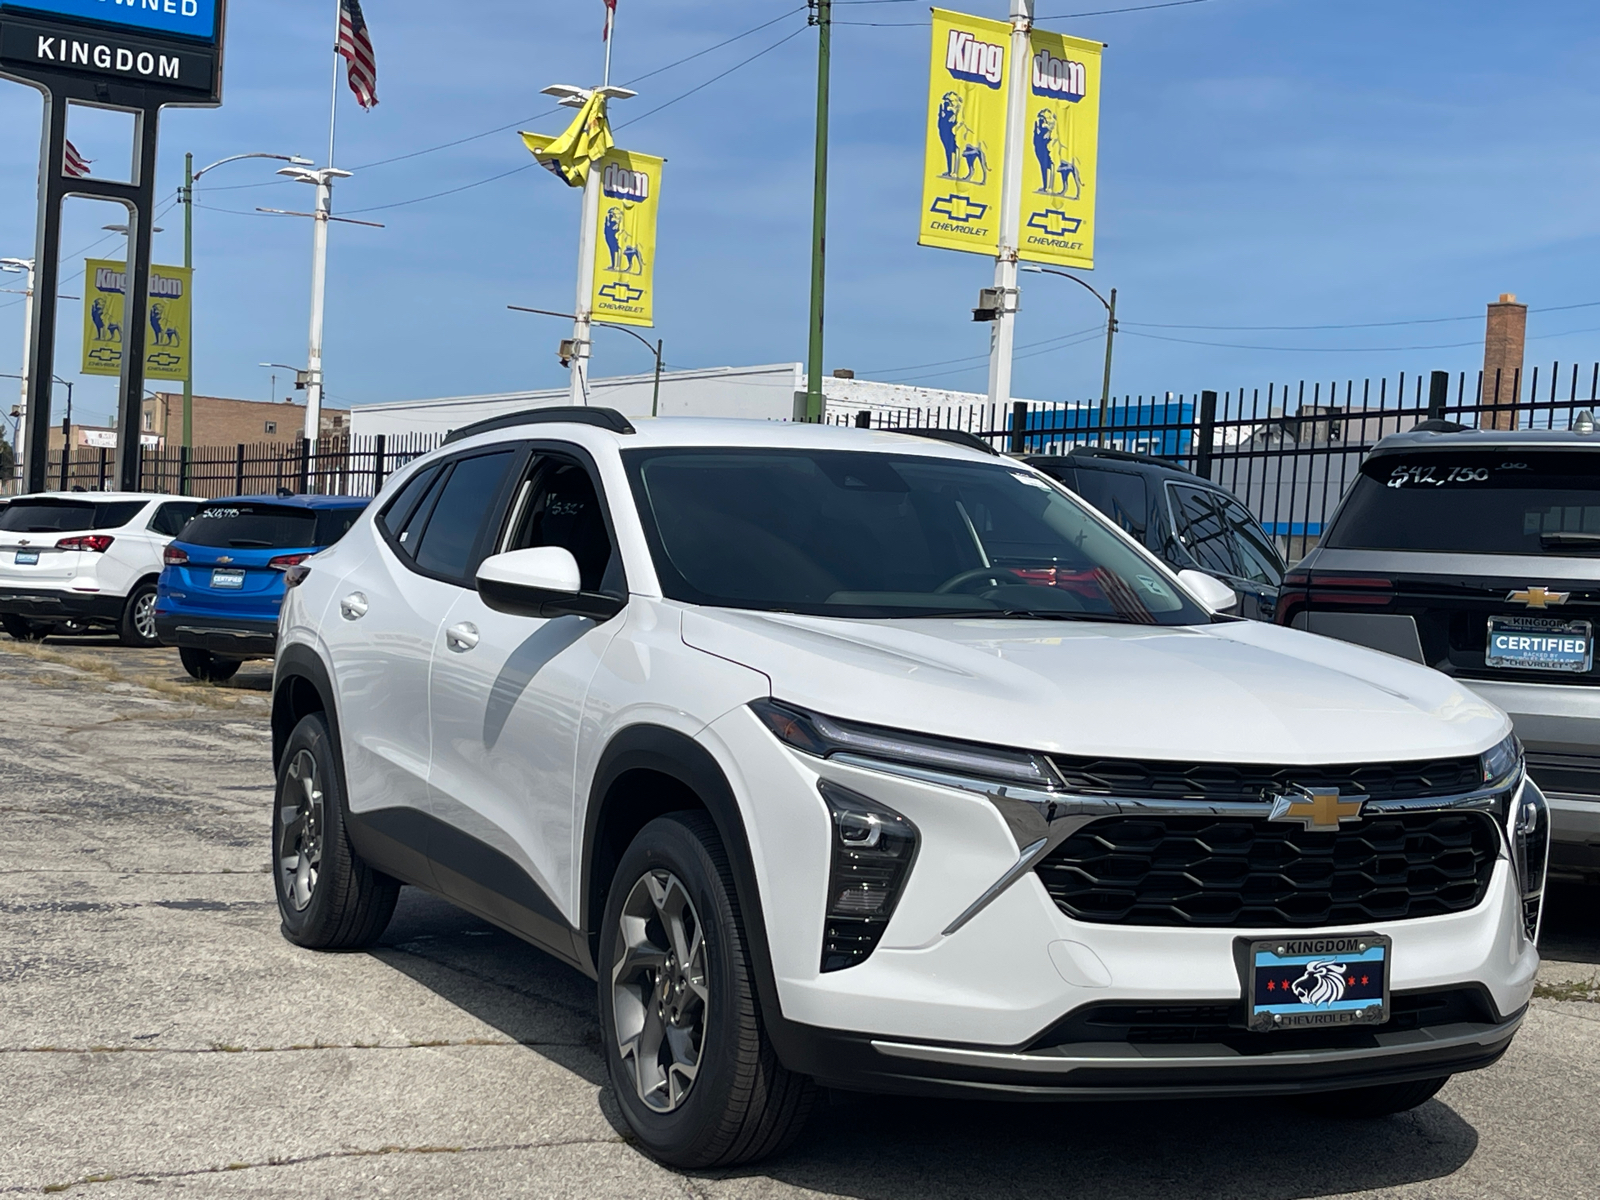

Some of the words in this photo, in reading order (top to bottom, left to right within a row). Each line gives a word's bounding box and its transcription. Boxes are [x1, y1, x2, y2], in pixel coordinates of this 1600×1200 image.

[99, 0, 198, 17] NED
[37, 36, 180, 79] KINGDOM
[946, 29, 1004, 86] King
[1032, 49, 1086, 100] dom
[604, 162, 649, 200] dom
[930, 221, 988, 237] CHEVROLET
[1027, 236, 1083, 250] CHEVROLET
[96, 267, 126, 293] King
[598, 302, 645, 313] CHEVROLET
[1387, 465, 1489, 489] $42,750
[1496, 636, 1585, 653] CERTIFIED
[1286, 939, 1358, 954] KINGDOM
[1281, 1013, 1355, 1025] CHEVROLET
